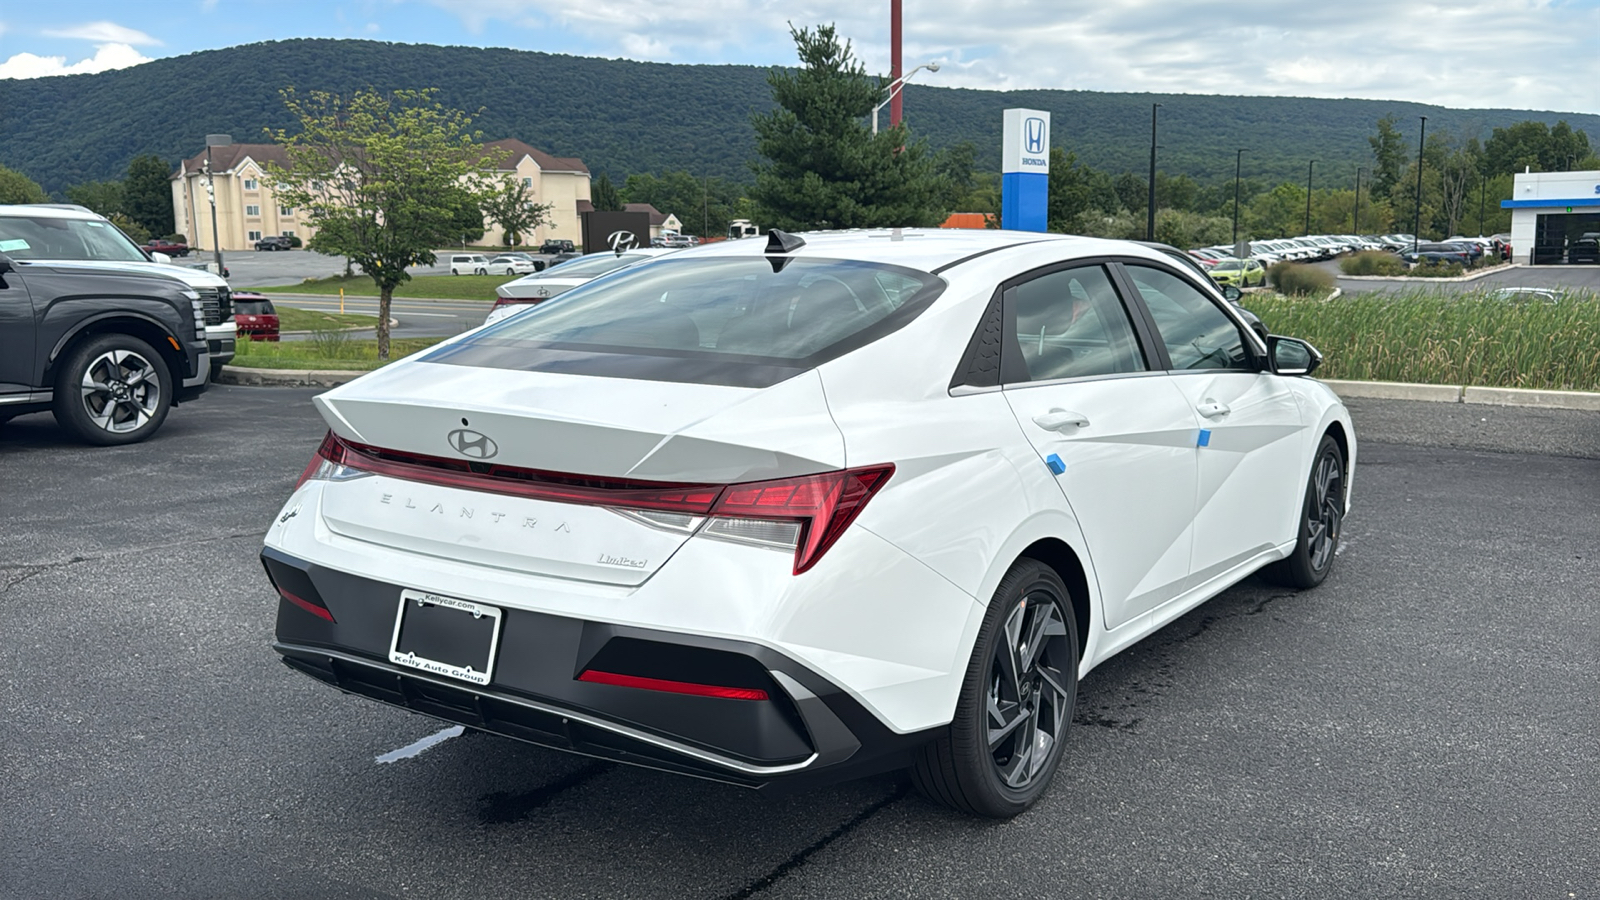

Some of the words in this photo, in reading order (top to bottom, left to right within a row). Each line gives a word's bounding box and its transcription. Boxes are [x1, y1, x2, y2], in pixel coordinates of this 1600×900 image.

[1022, 157, 1047, 166] HONDA
[596, 553, 648, 568] Limited
[425, 594, 475, 610] Kellycar.com
[394, 655, 421, 667] Kelly
[423, 663, 449, 674] Auto
[451, 670, 485, 683] Group
